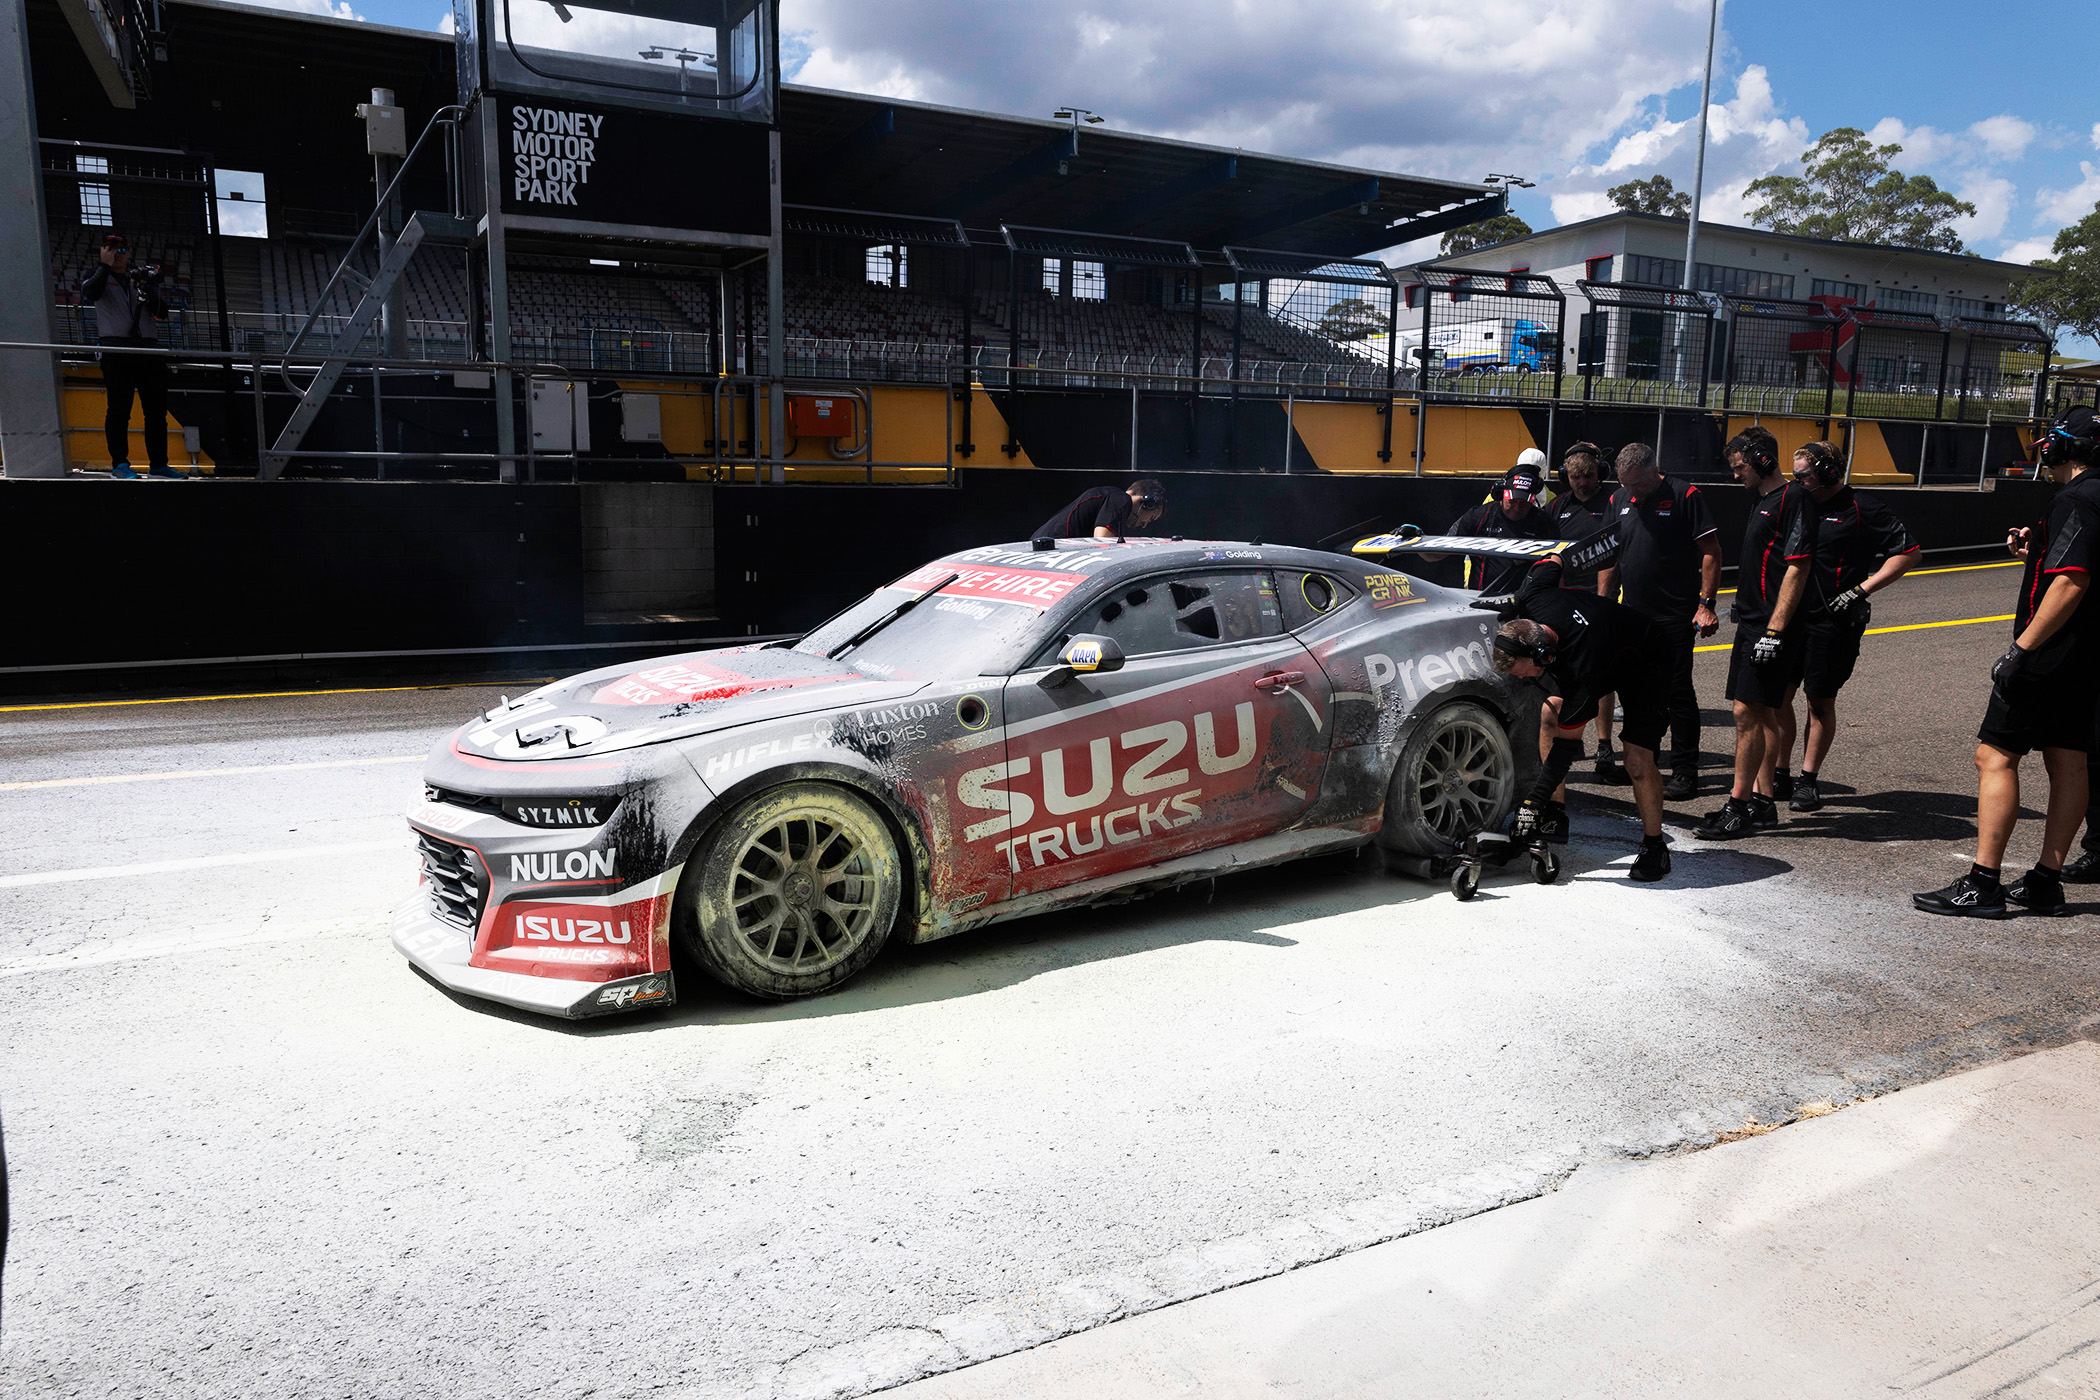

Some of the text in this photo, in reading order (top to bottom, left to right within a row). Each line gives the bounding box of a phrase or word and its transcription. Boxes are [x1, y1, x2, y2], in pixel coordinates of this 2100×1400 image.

[512, 105, 604, 139] SYDNEY
[512, 130, 596, 162] MOTOR
[514, 154, 592, 184] SPORT
[514, 177, 578, 206] PARK
[1225, 550, 1262, 560] Golding
[1412, 537, 1555, 555] RACING
[1571, 534, 1620, 568] SYZMIK
[979, 573, 1074, 600] HIRE
[1364, 574, 1410, 589] POWER
[934, 599, 996, 620] Golding
[1070, 649, 1097, 664] NAPA
[855, 700, 940, 728] Luxton
[863, 725, 927, 747] HOMES
[517, 806, 600, 825] SYZMIK
[995, 788, 1202, 873] TRUCKS
[510, 847, 617, 882] NULON
[516, 914, 632, 944] ISUZU
[537, 946, 609, 962] TRUCKS
